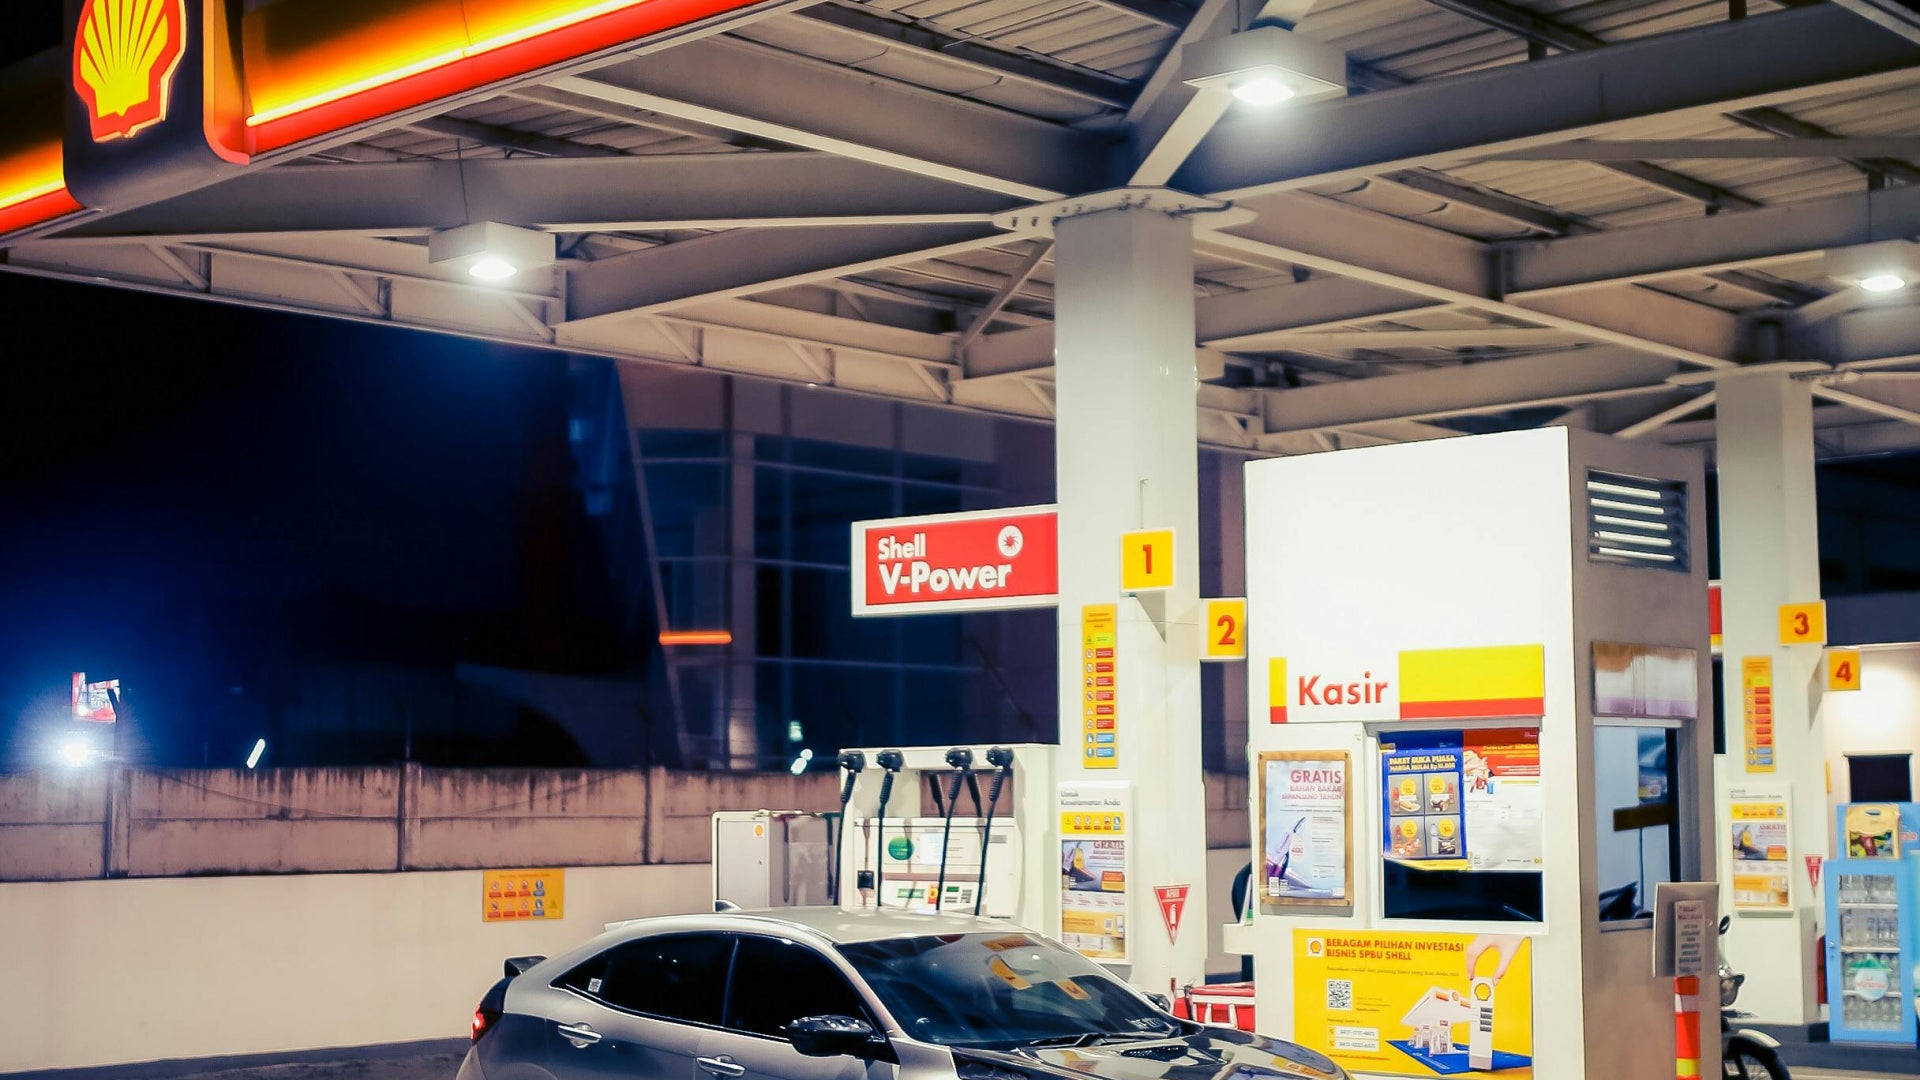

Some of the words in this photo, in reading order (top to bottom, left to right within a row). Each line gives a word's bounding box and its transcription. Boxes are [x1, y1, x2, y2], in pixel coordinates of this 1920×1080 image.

[877, 533, 926, 560] Shell
[1142, 544, 1152, 574] 1
[878, 560, 1012, 595] V-Power
[1217, 614, 1236, 645] 2
[1794, 611, 1810, 635] 3
[1835, 660, 1853, 682] 4
[1298, 670, 1388, 706] Kasir
[1290, 769, 1342, 784] GRATIS
[1326, 938, 1372, 948] BERAGAM
[1374, 940, 1412, 950] PILIHAN
[1415, 941, 1464, 952] INVESTASI
[1326, 949, 1357, 958] BISNIS
[1359, 950, 1383, 959] SPBU
[1386, 951, 1412, 960] SHELL
